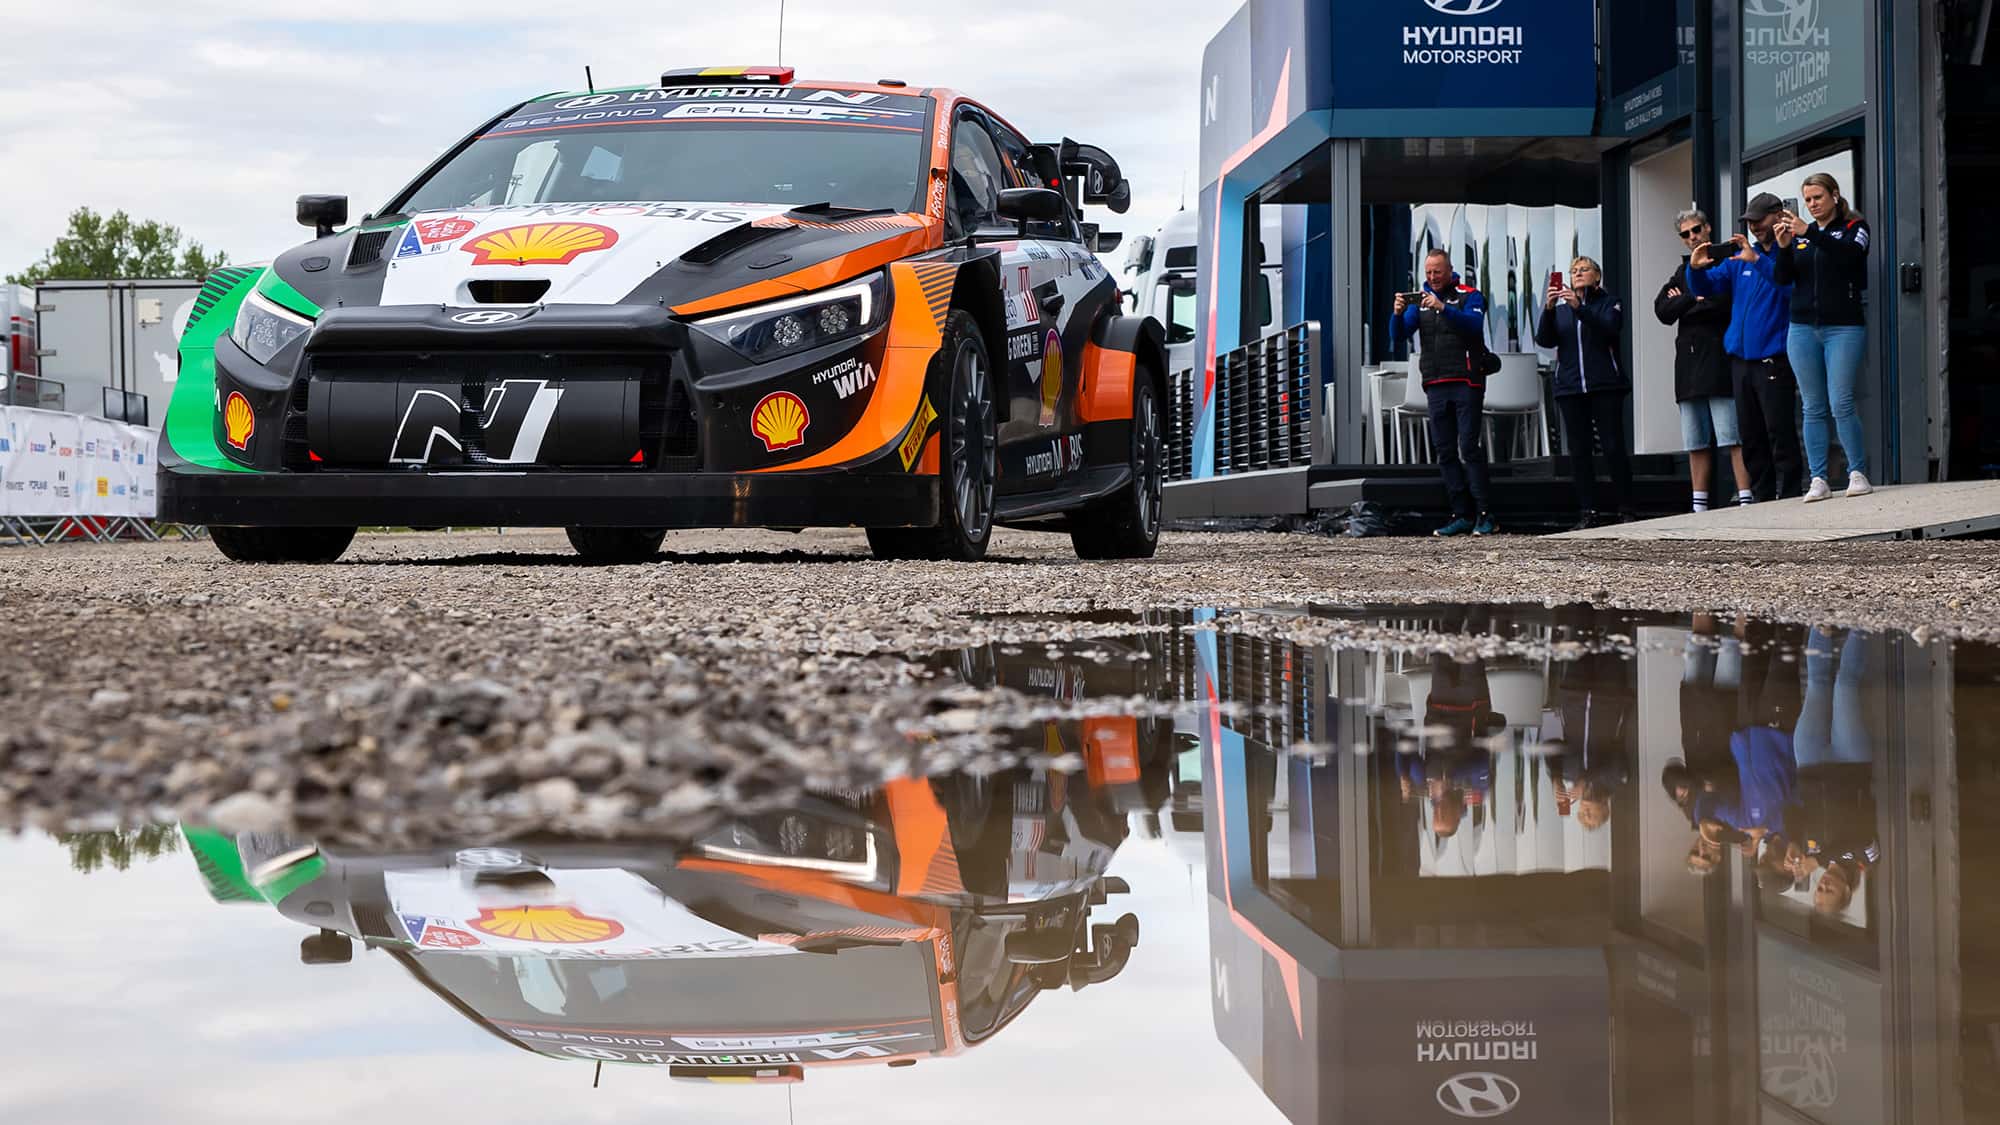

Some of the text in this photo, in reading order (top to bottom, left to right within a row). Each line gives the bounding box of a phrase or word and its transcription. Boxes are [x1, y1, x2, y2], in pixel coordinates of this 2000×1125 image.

[1403, 26, 1523, 46] HYUNDAI
[1403, 49, 1523, 64] MOTORSPORT
[628, 88, 793, 102] HYUNDAI
[504, 105, 812, 129] BEYOND RALLY
[524, 206, 748, 223] MOBIS
[812, 357, 856, 384] HYUNDAI
[832, 362, 876, 400] WIA
[1025, 433, 1083, 476] HYUNDAI MOBIS
